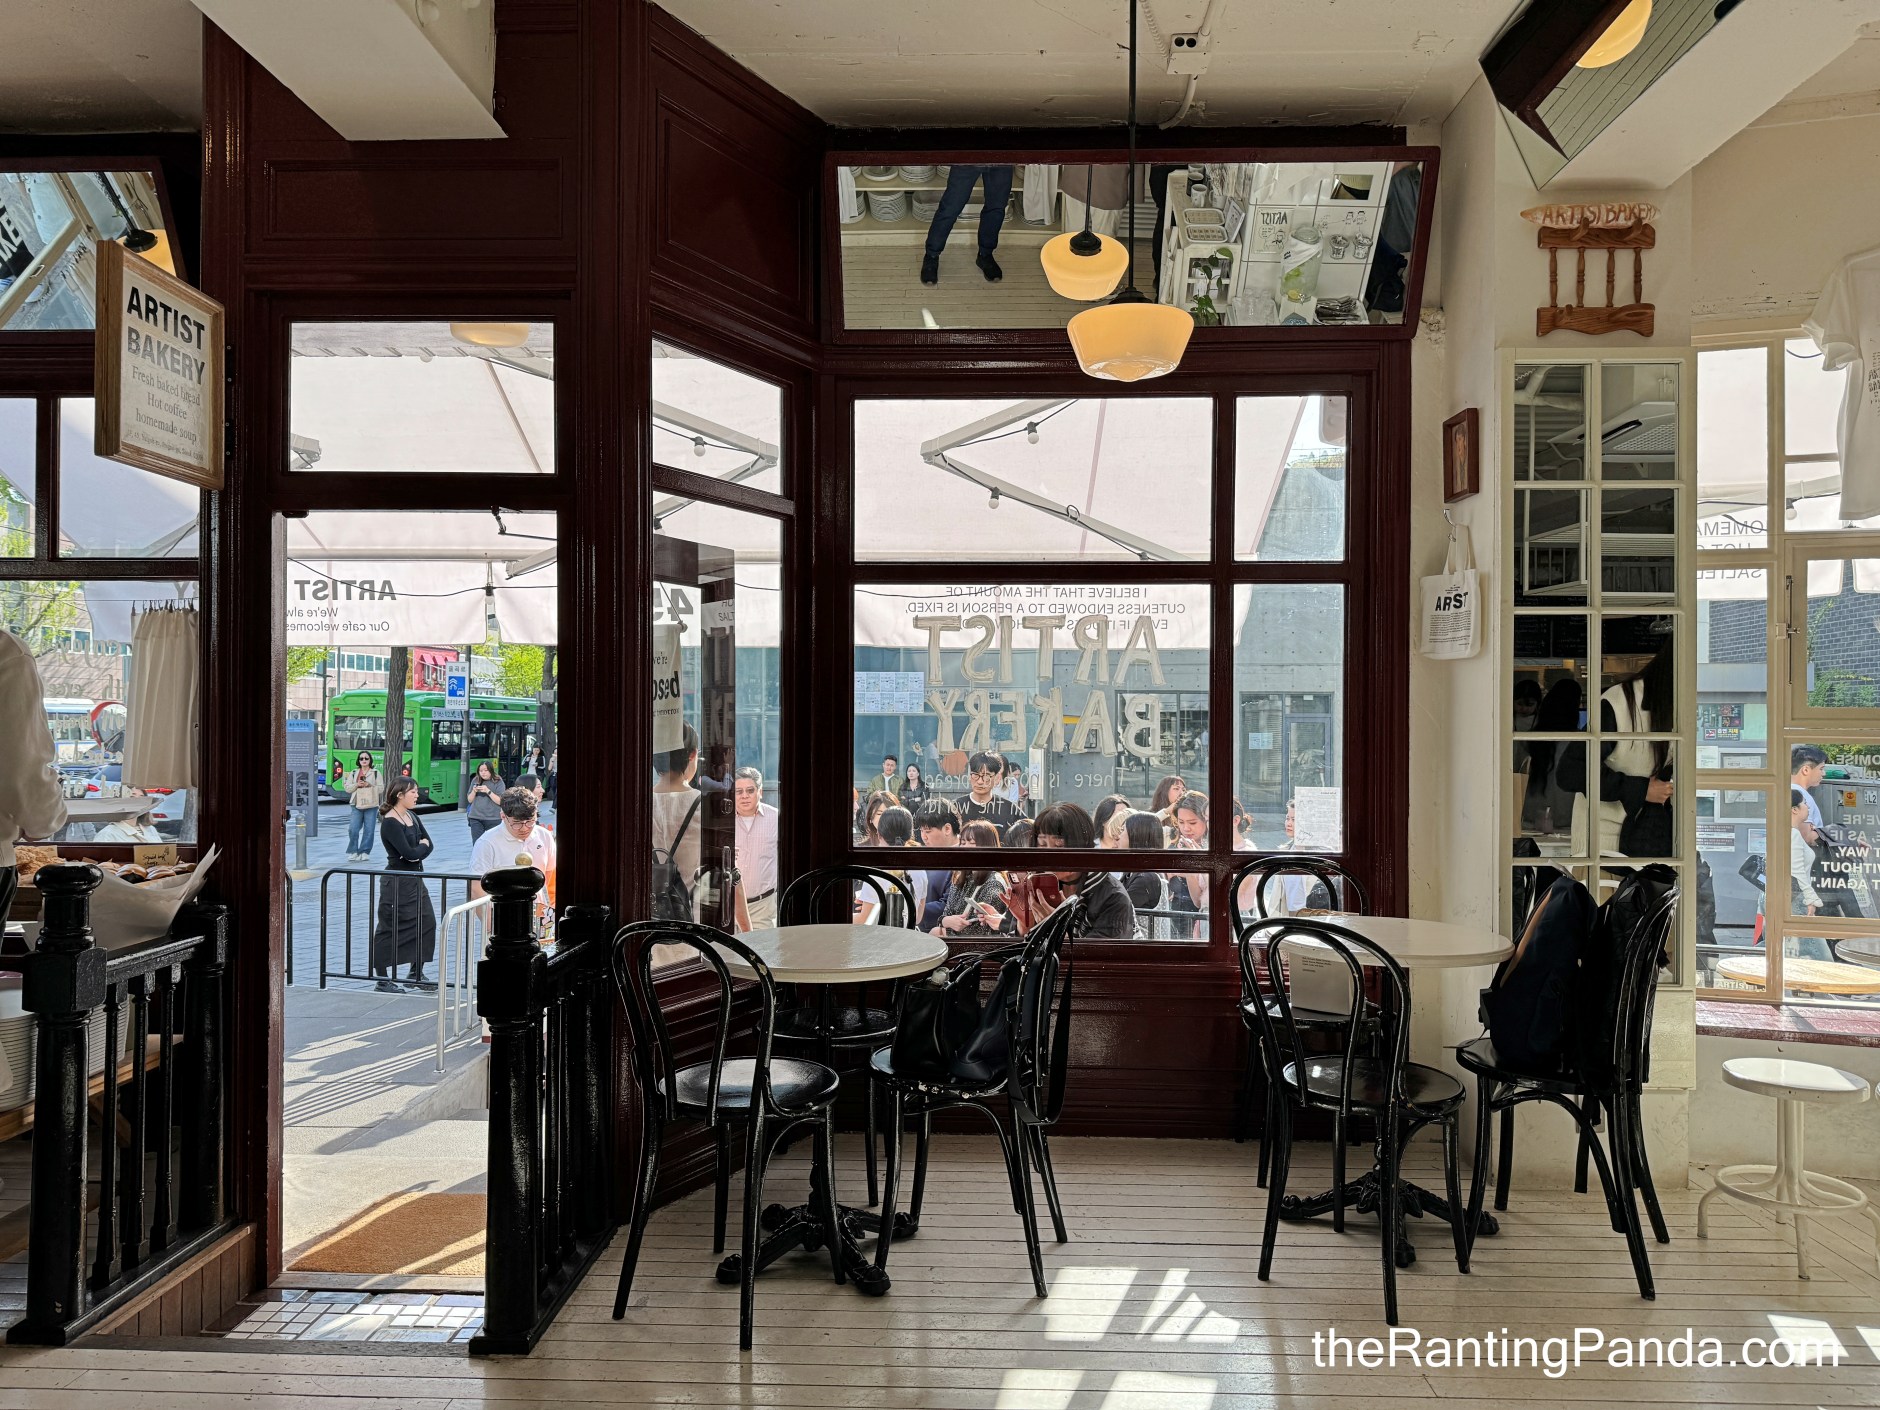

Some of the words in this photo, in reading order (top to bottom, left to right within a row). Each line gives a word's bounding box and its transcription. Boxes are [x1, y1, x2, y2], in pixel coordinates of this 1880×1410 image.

[127, 286, 205, 350] ARTIST
[127, 325, 205, 386] BAKERY
[132, 365, 155, 387] Fresh
[157, 375, 179, 397] baked
[180, 386, 201, 406] bread
[147, 392, 163, 410] Hot
[164, 401, 188, 420] coffee
[135, 408, 178, 436] homemade
[179, 428, 197, 446] soup
[1435, 592, 1468, 611] ARST
